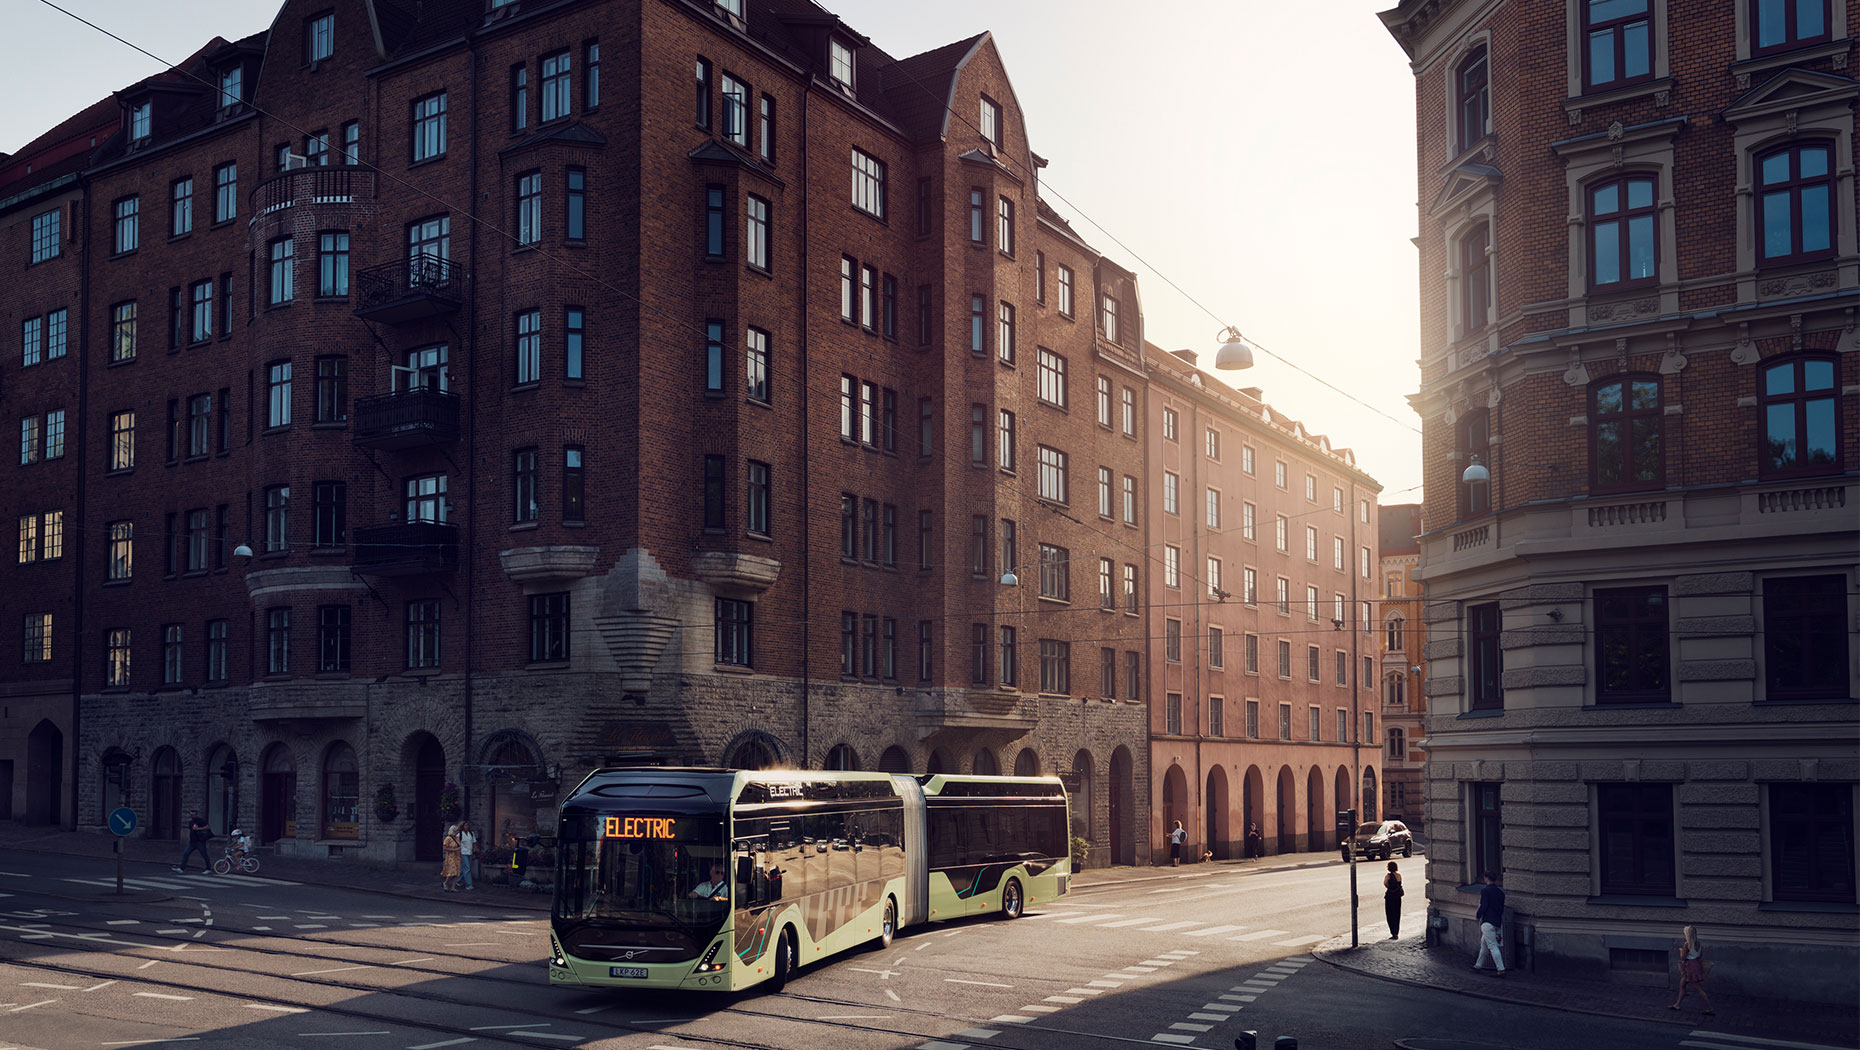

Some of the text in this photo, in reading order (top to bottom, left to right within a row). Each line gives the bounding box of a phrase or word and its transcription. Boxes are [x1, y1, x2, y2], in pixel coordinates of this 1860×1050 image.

[769, 786, 804, 797] ELECTRIC
[605, 816, 677, 839] ELECTRIC
[615, 968, 629, 976] LKP
